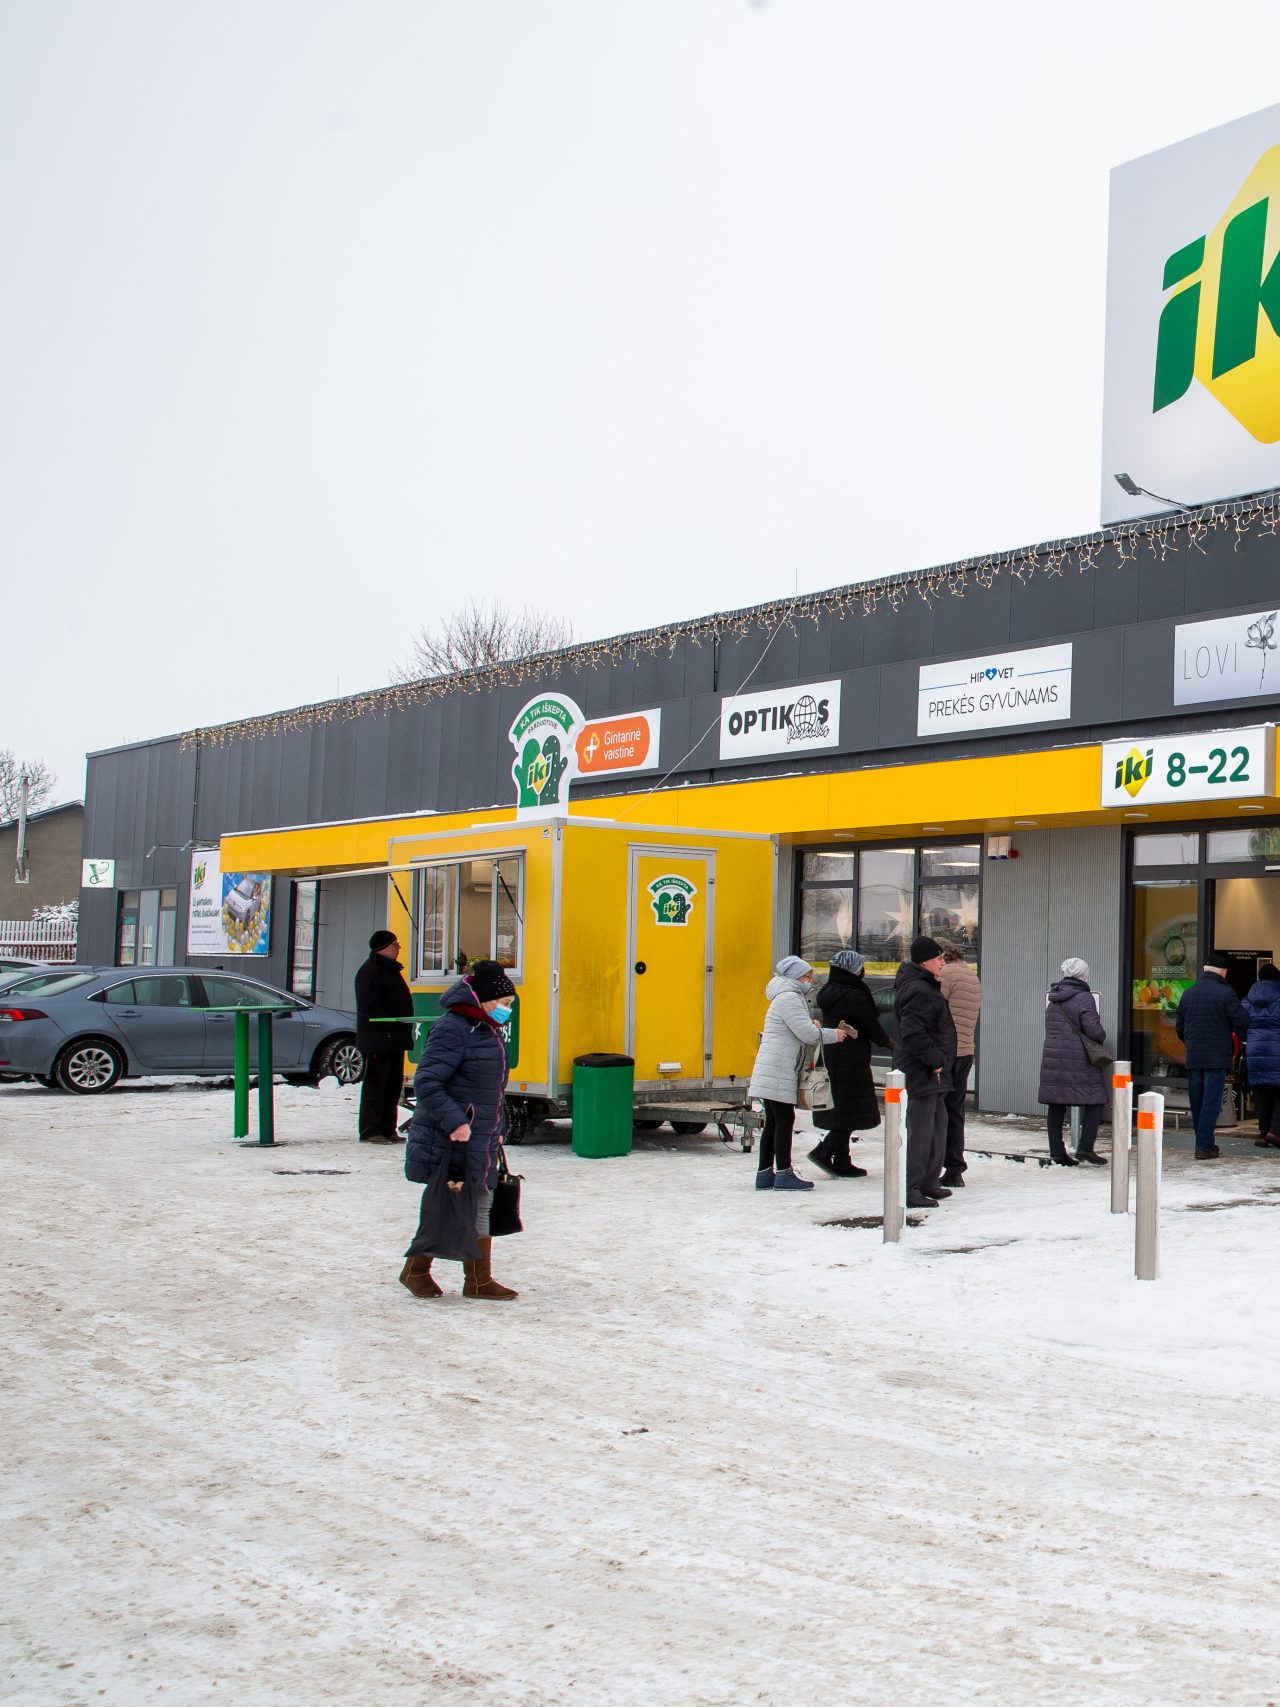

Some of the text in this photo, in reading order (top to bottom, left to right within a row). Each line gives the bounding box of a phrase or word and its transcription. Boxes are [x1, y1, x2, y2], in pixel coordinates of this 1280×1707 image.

[1184, 642, 1236, 680] LOVI
[530, 705, 541, 718] TIK
[541, 702, 567, 723] IŠKEPTA
[929, 685, 1058, 718] PREKĖS GYVŪNAMS
[604, 729, 641, 745] Gintarinė
[603, 744, 635, 761] vaistinė
[527, 753, 553, 788] iki
[1115, 746, 1250, 789] iki 8-22
[194, 862, 206, 884] iki
[664, 901, 680, 914] iki
